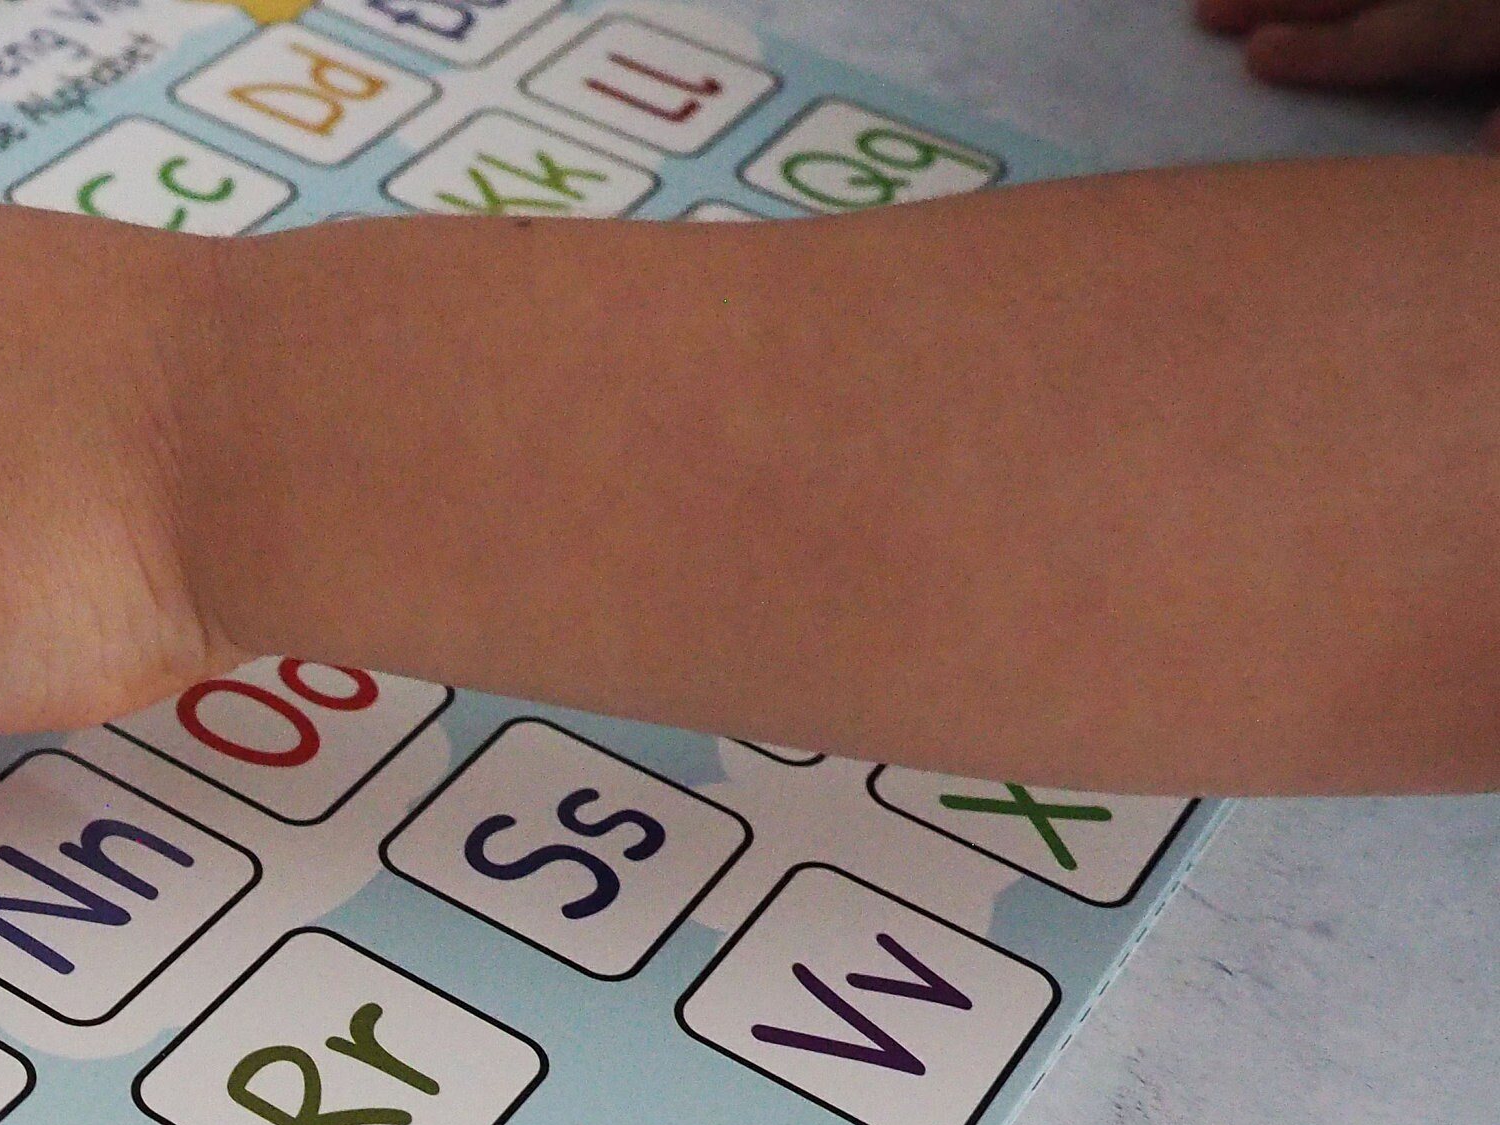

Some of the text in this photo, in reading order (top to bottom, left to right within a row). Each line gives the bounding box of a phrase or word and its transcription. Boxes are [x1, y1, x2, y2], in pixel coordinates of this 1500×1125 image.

[227, 47, 387, 137] Dd
[584, 52, 725, 123] Ll
[780, 127, 994, 212] Qq
[463, 787, 666, 920] Ss
[751, 932, 974, 1077] Vv
